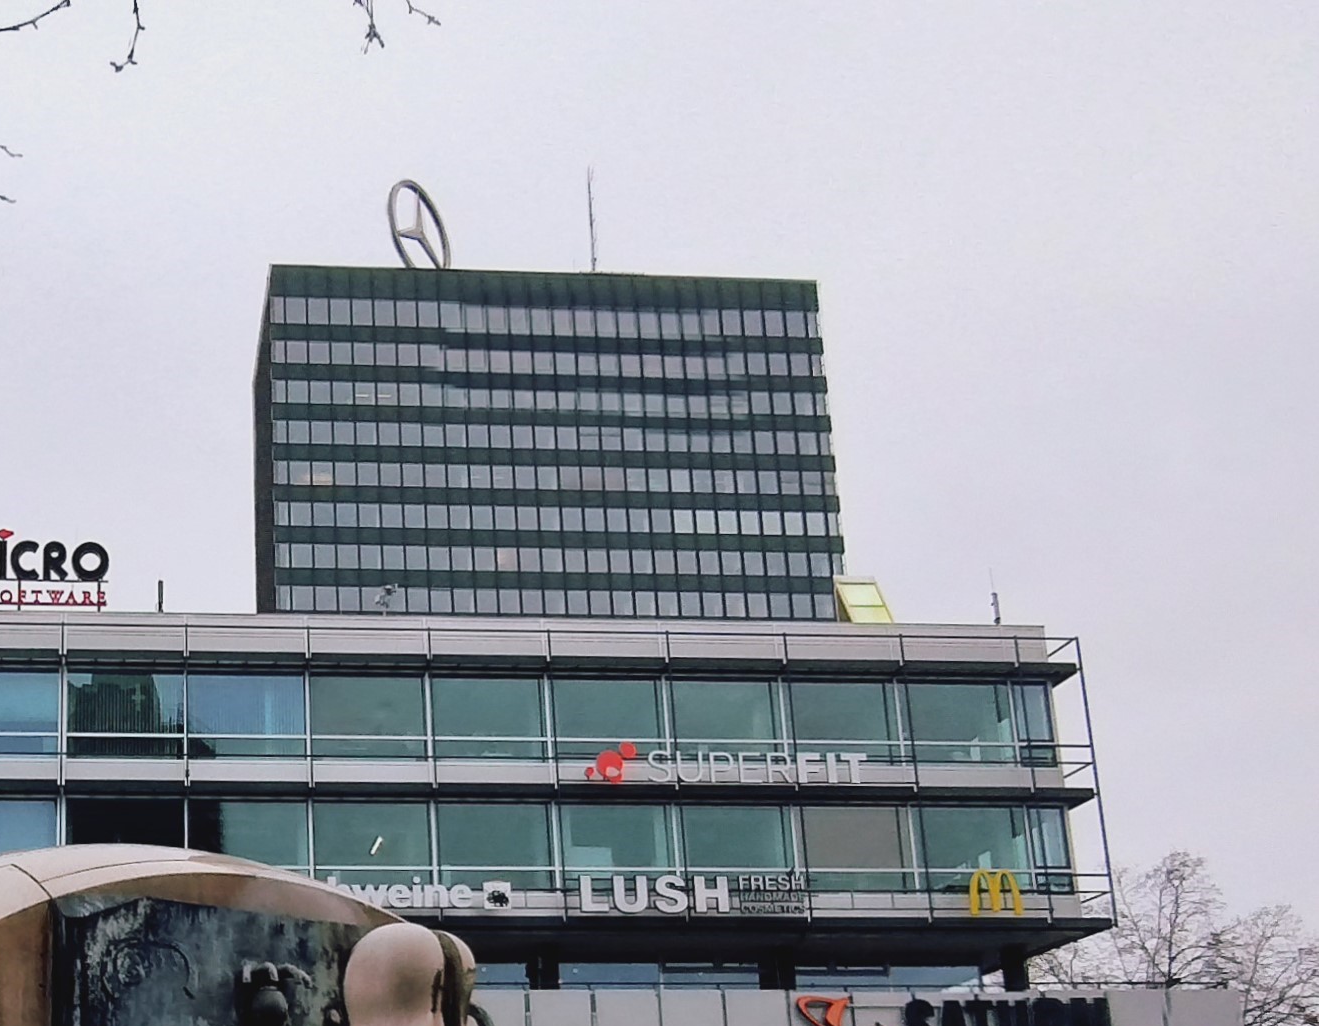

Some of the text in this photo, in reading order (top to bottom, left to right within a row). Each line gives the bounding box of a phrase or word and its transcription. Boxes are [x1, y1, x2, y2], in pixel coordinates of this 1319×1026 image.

[647, 750, 868, 784] SUPERFIT
[738, 874, 806, 891] FRESH
[579, 874, 731, 914] LUSH
[740, 891, 806, 902] HANDMADE
[741, 903, 806, 915] COSMETICS
